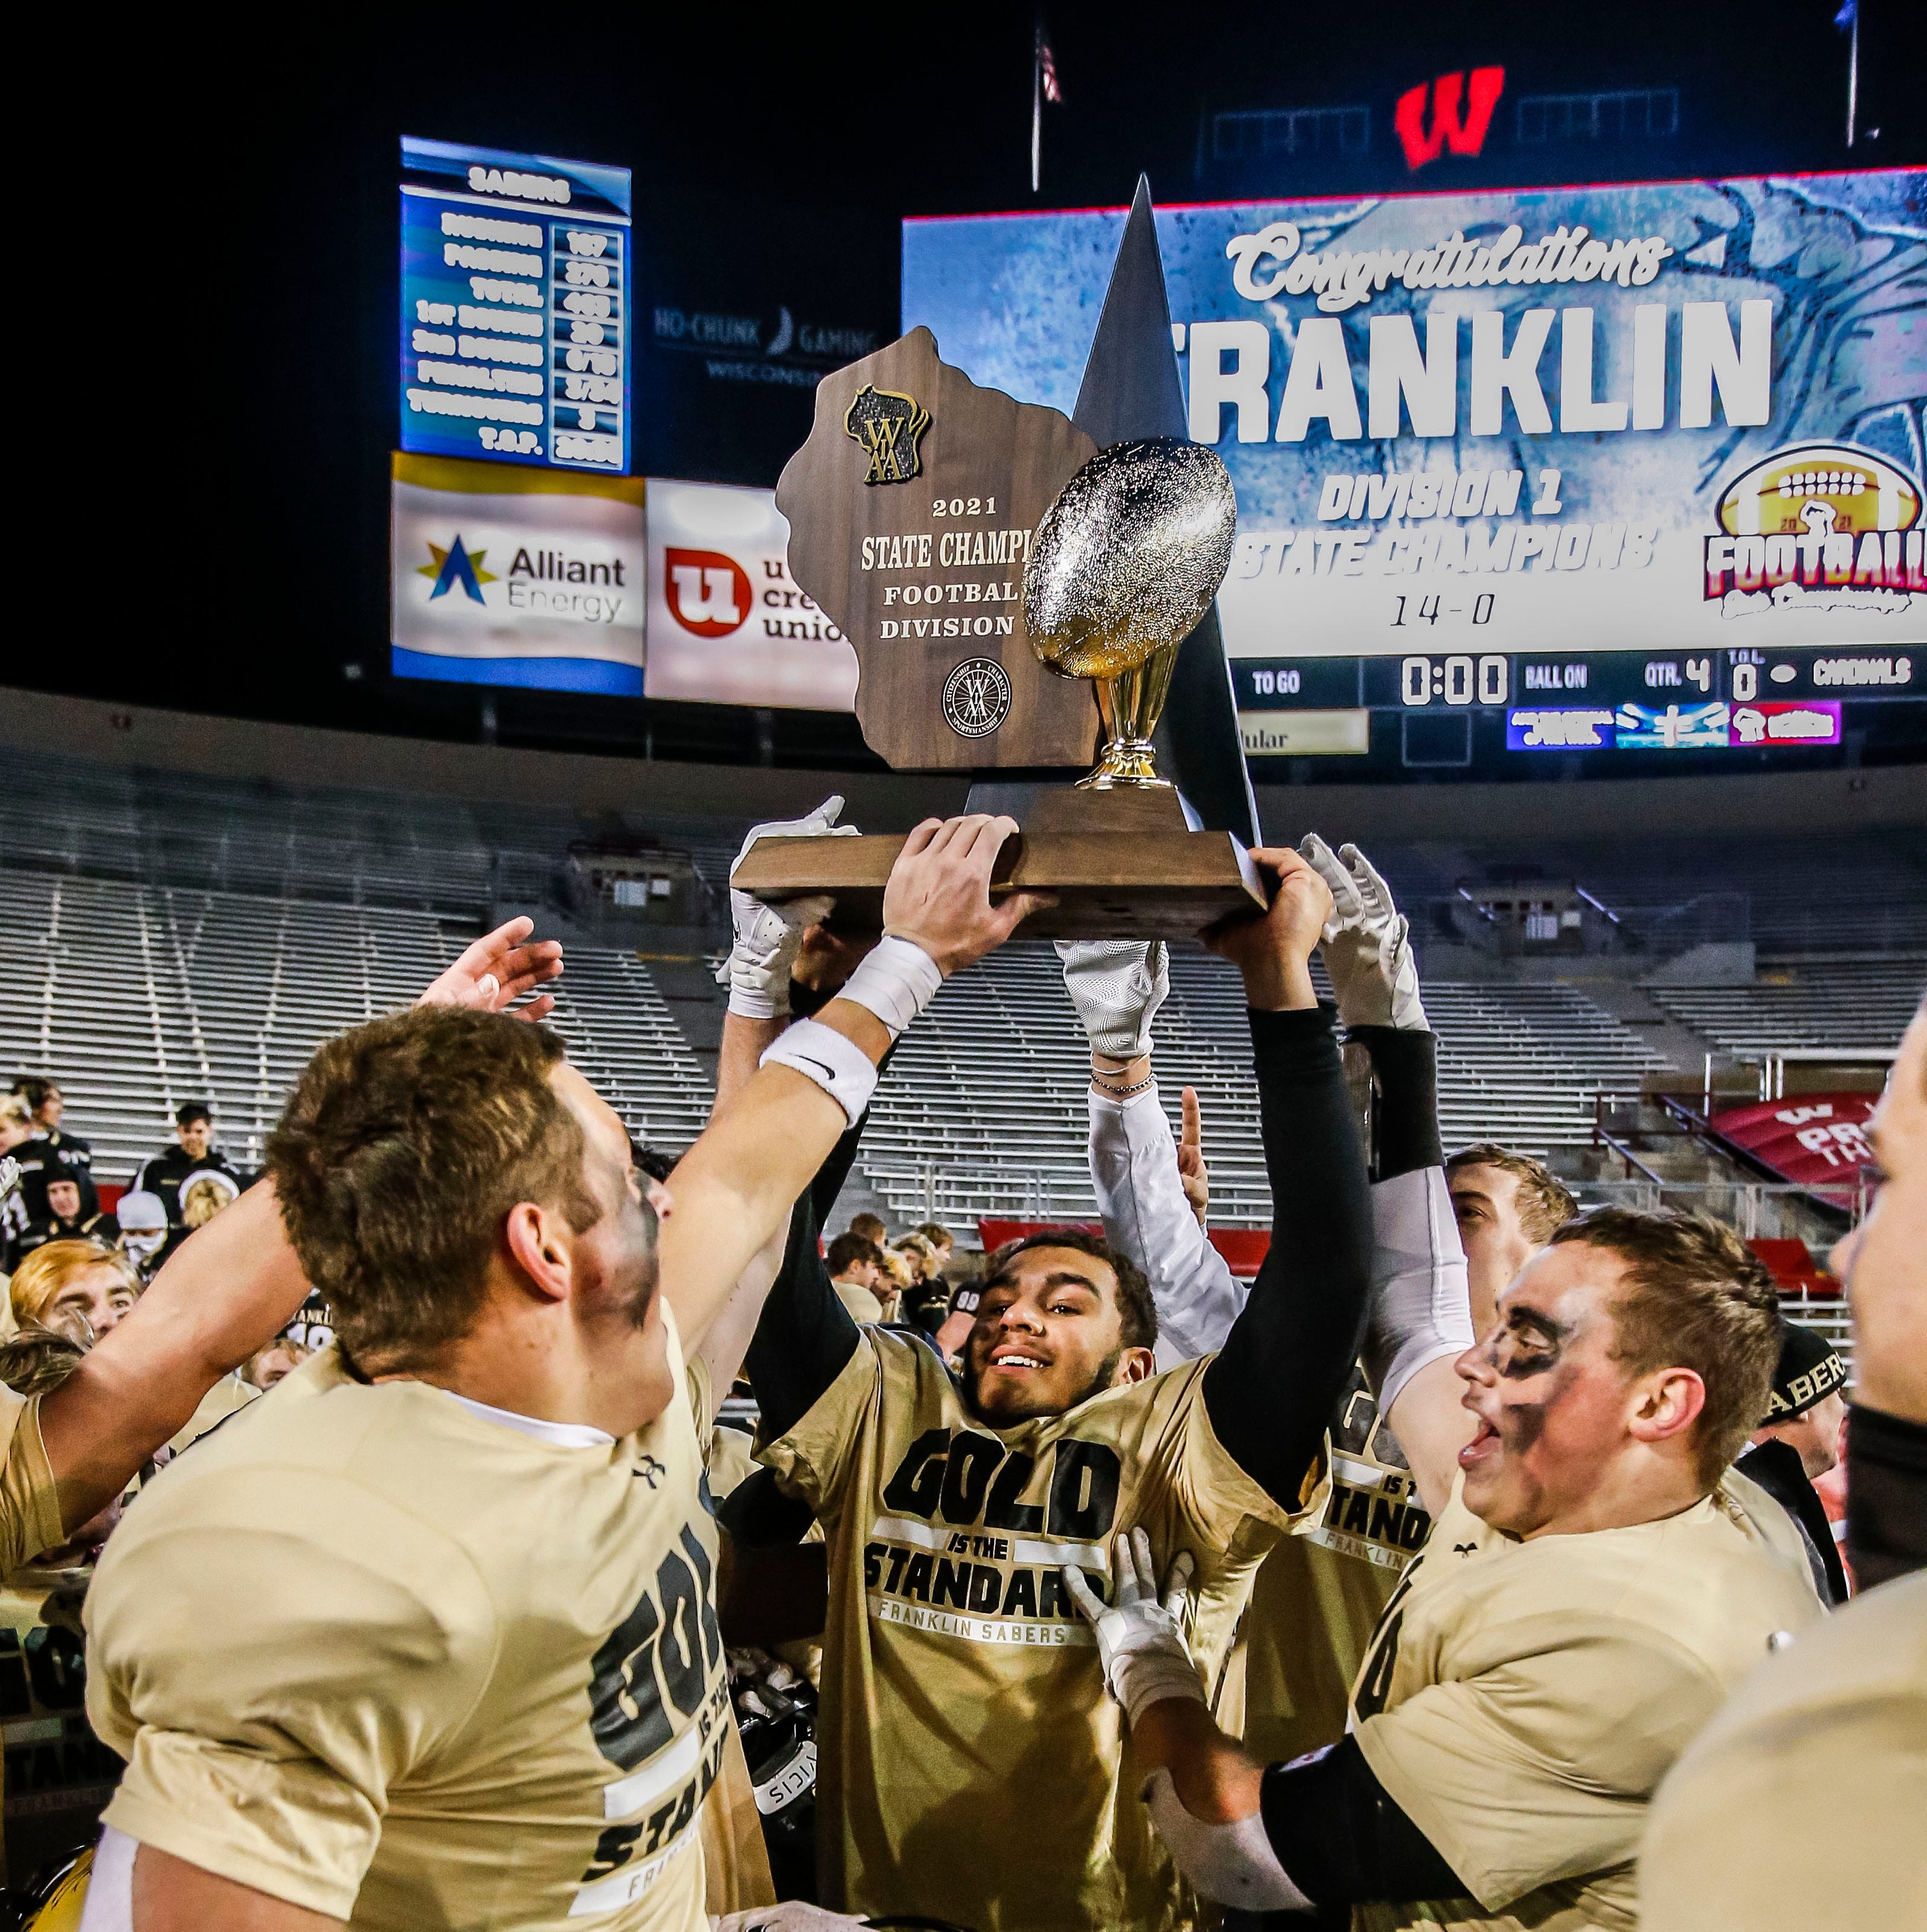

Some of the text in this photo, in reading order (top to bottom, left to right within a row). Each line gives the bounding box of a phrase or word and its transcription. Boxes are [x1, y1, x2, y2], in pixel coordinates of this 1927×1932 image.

[1394, 65, 1505, 170] W
[1226, 222, 1673, 313] Congratulations
[1171, 299, 1773, 444] RANKLIN
[932, 496, 996, 518] 2021
[1317, 468, 1563, 522] DIVISION 1
[509, 547, 626, 586] Alliant
[861, 529, 1032, 571] STATE CHAMPI
[1233, 522, 1659, 579] STATE CHAMPIONS
[1707, 530, 1927, 597] FOOTBALL
[508, 579, 623, 623] Energy
[763, 589, 815, 610] cre
[883, 582, 1018, 606] FOOTBAL
[763, 615, 842, 641] unio
[879, 616, 1015, 639] DIVISION
[946, 665, 970, 702] CITIZENSHIP
[987, 665, 1008, 701] CHARACTER
[1252, 670, 1300, 695] TO GO
[1401, 656, 1509, 705] 0:00
[1525, 664, 1588, 689] BALL ON
[1685, 658, 1711, 693] 4
[1732, 664, 1759, 702] 0
[952, 716, 999, 734] SPORTSMANSHIP
[1796, 1120, 1874, 1151] PR
[882, 1427, 1121, 1540] GOLD
[1384, 1474, 1405, 1495] IS
[946, 1532, 1009, 1561] IS THE
[879, 1600, 1066, 1644] FRANKLIN SABERS
